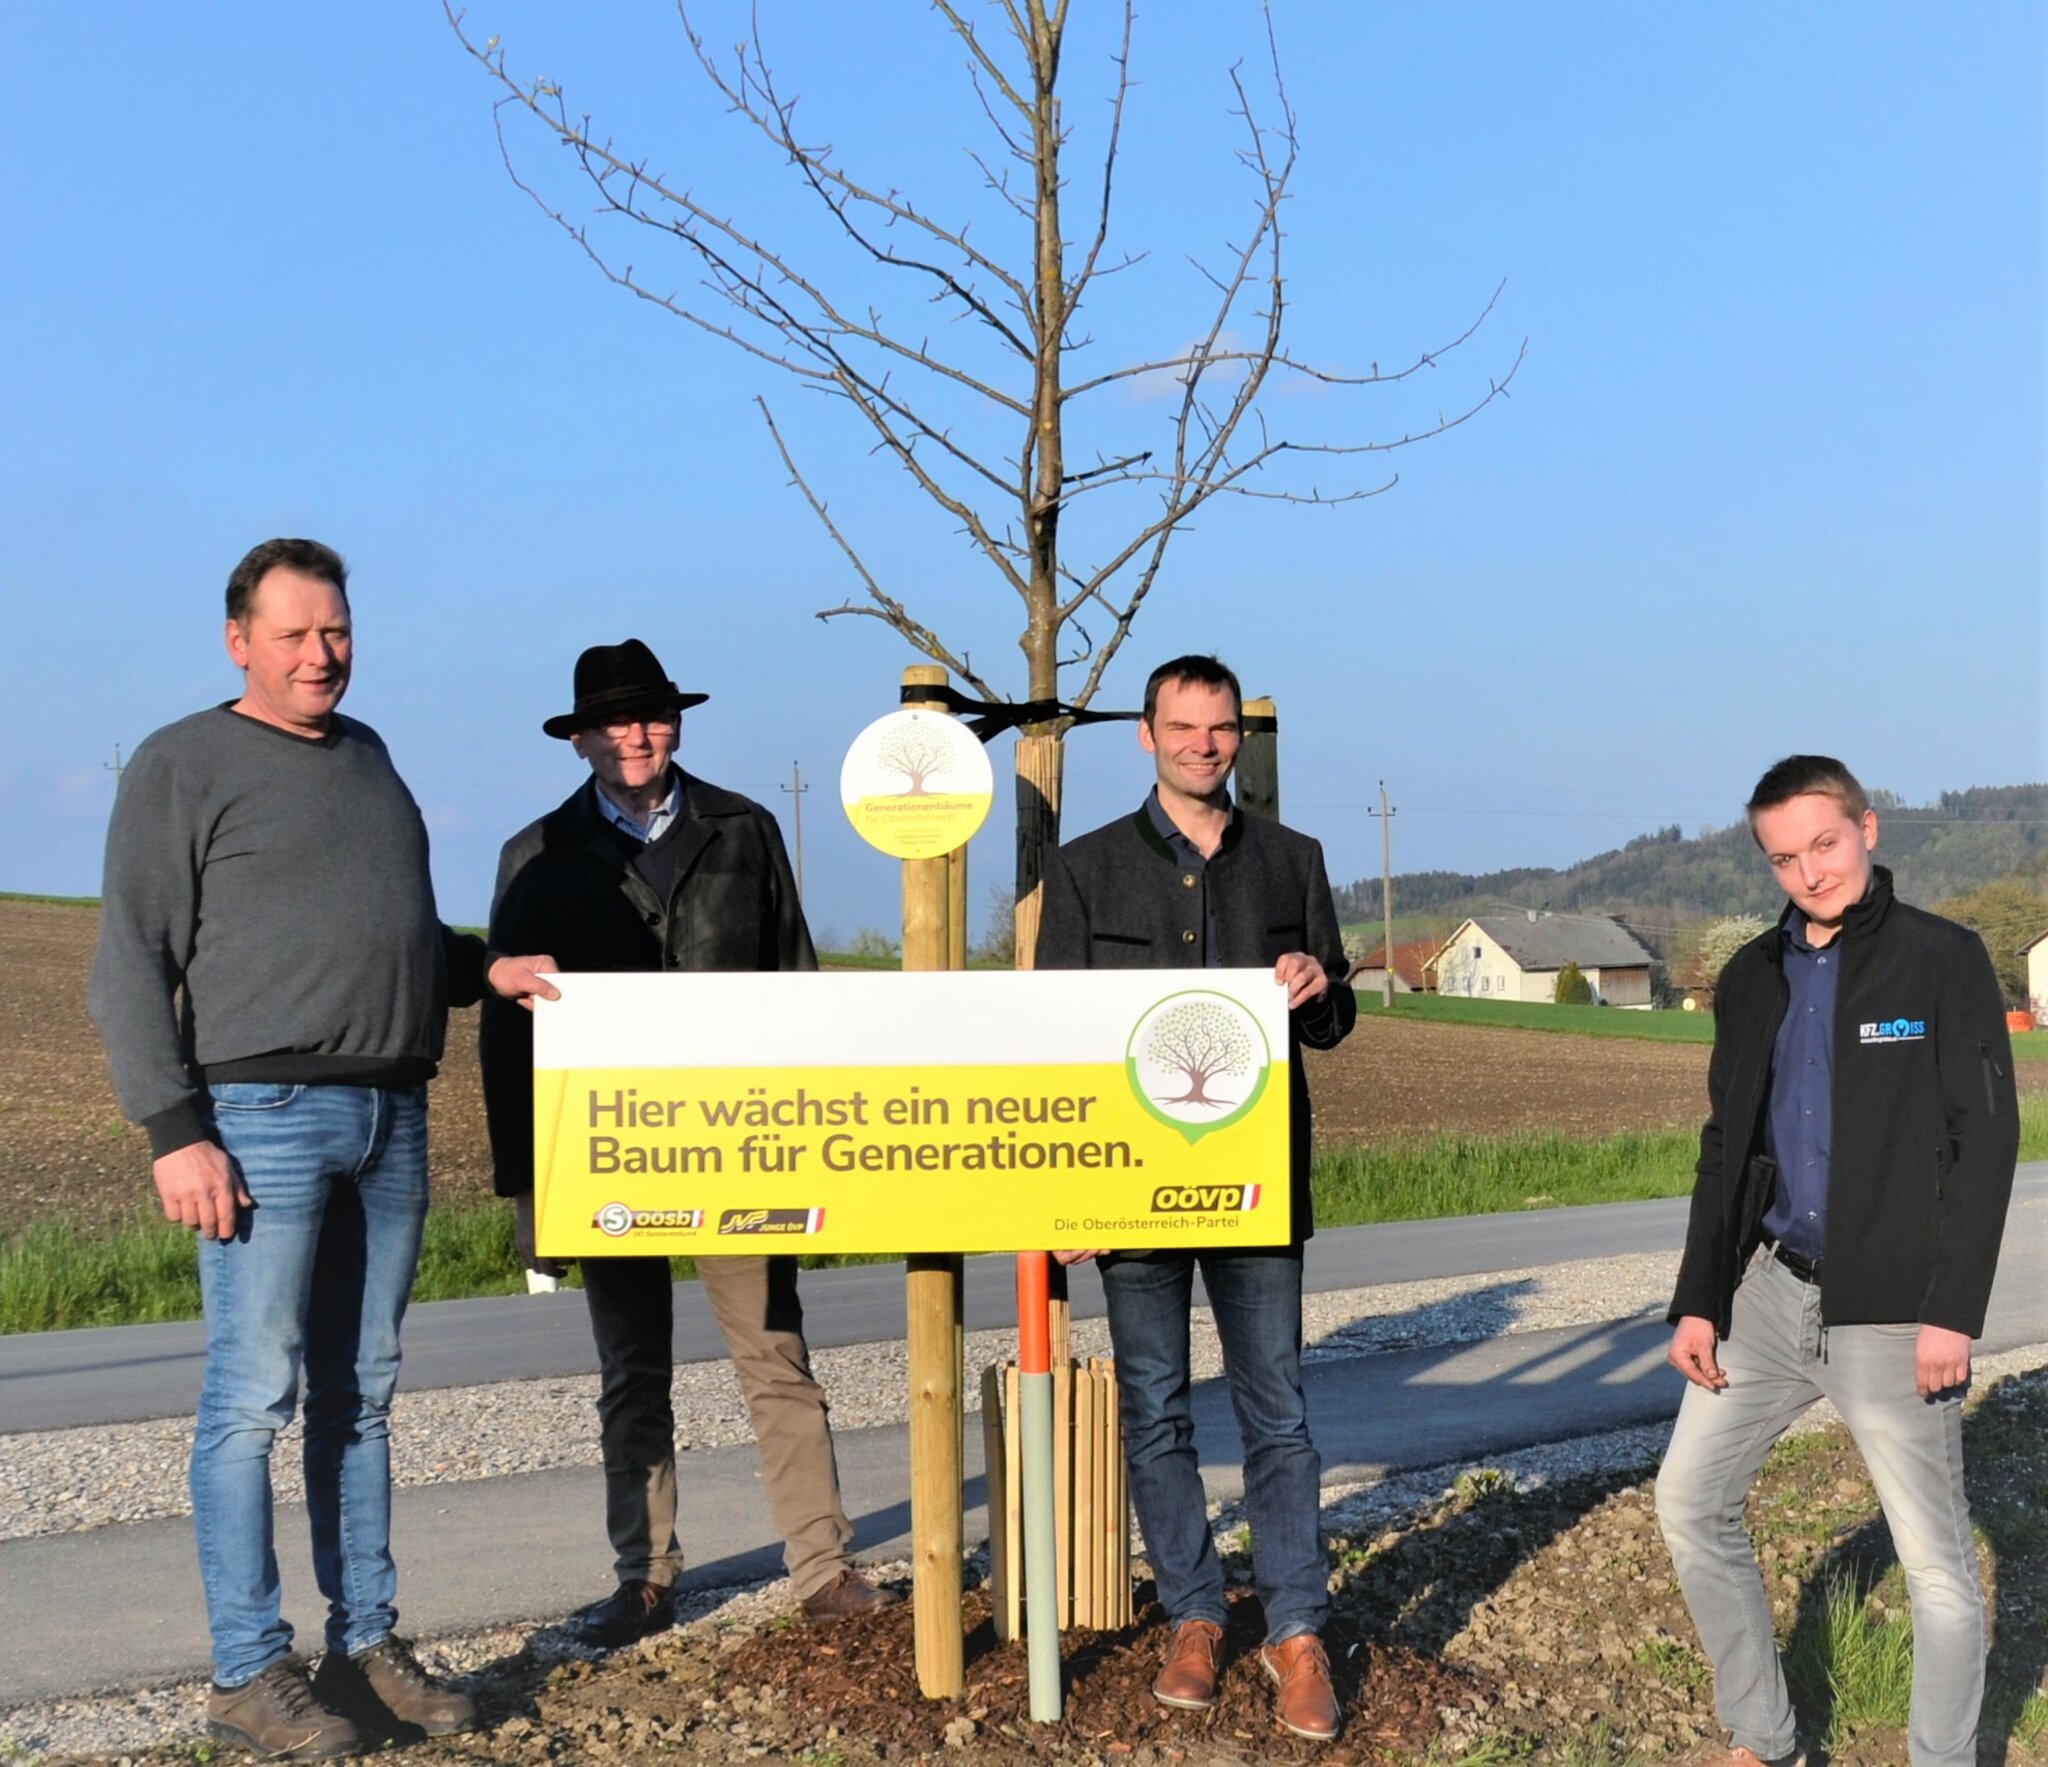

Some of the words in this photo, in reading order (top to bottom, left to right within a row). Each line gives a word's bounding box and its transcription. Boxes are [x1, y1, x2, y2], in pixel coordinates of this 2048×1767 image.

[865, 801, 973, 813] Generationenbäume
[865, 813, 880, 824] für
[588, 1089, 686, 1128] Hier
[699, 1088, 868, 1128] wächst
[883, 1086, 949, 1126] ein
[966, 1095, 1097, 1124] neuer
[588, 1136, 722, 1174] Baum
[738, 1134, 806, 1173] für
[821, 1130, 1144, 1172] Generationen.
[1054, 1218, 1078, 1231] Die
[1082, 1215, 1240, 1231] Oberösterreich-Partei
